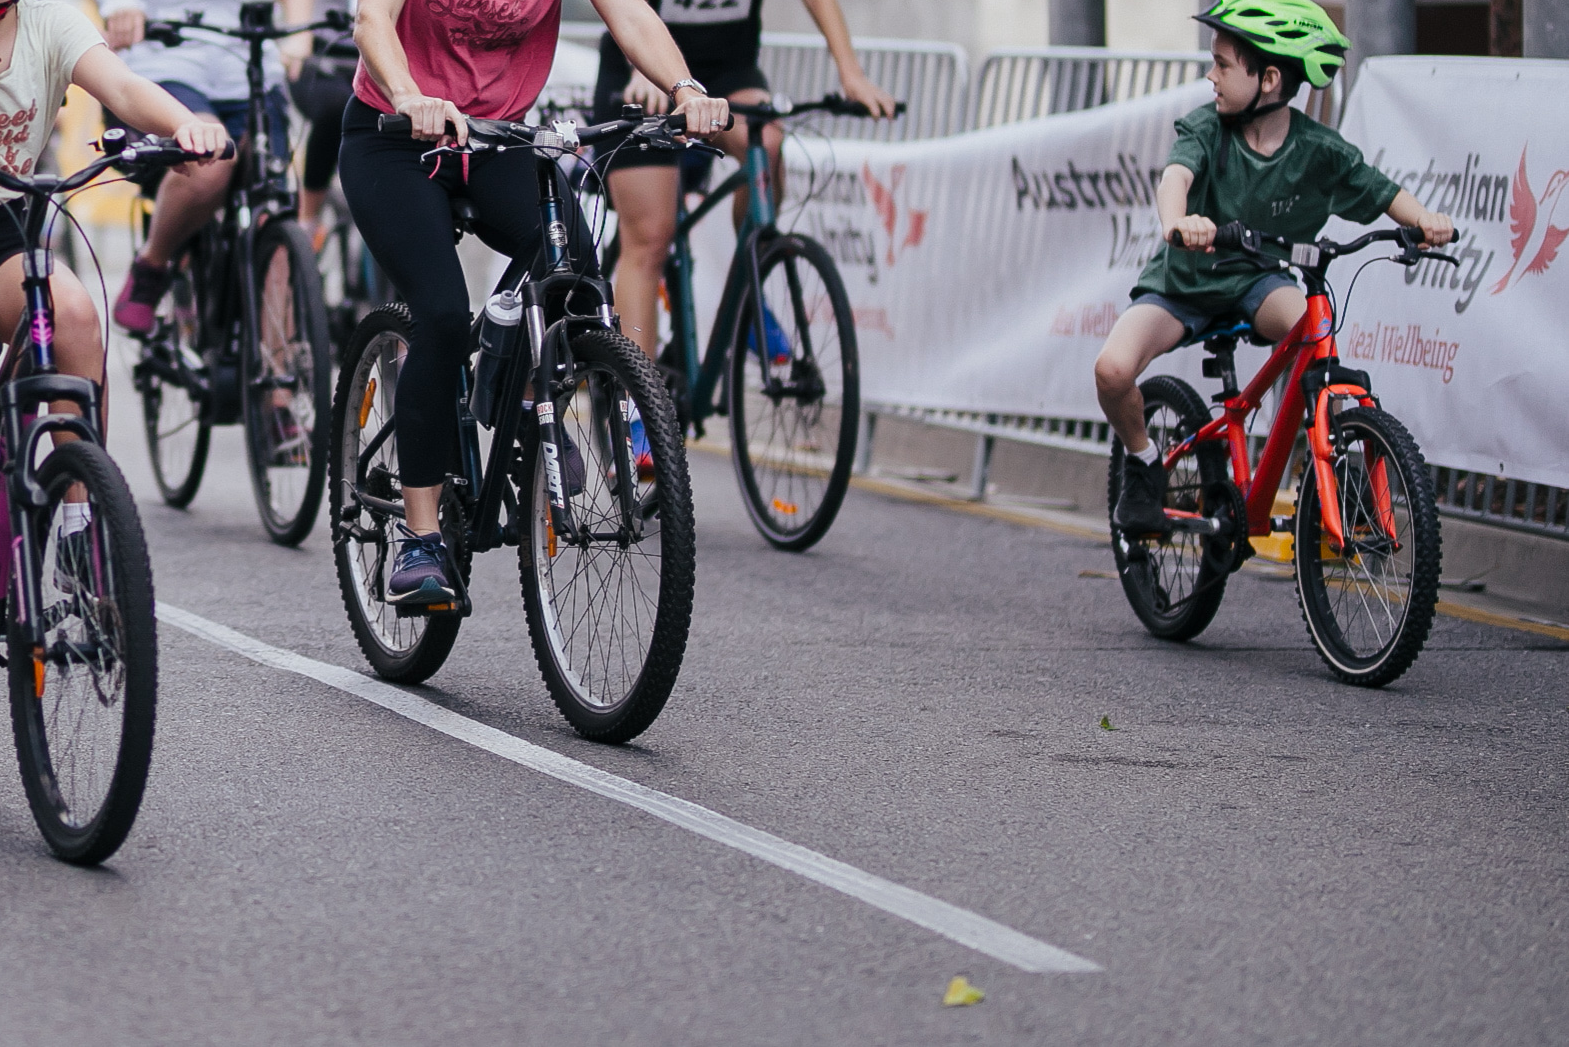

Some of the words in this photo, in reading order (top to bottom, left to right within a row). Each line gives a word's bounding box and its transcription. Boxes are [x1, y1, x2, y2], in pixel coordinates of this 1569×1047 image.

[1011, 152, 1166, 211] Australi
[1370, 147, 1509, 223] stralian
[1345, 320, 1381, 361] Real
[1381, 323, 1460, 384] Wellbeing
